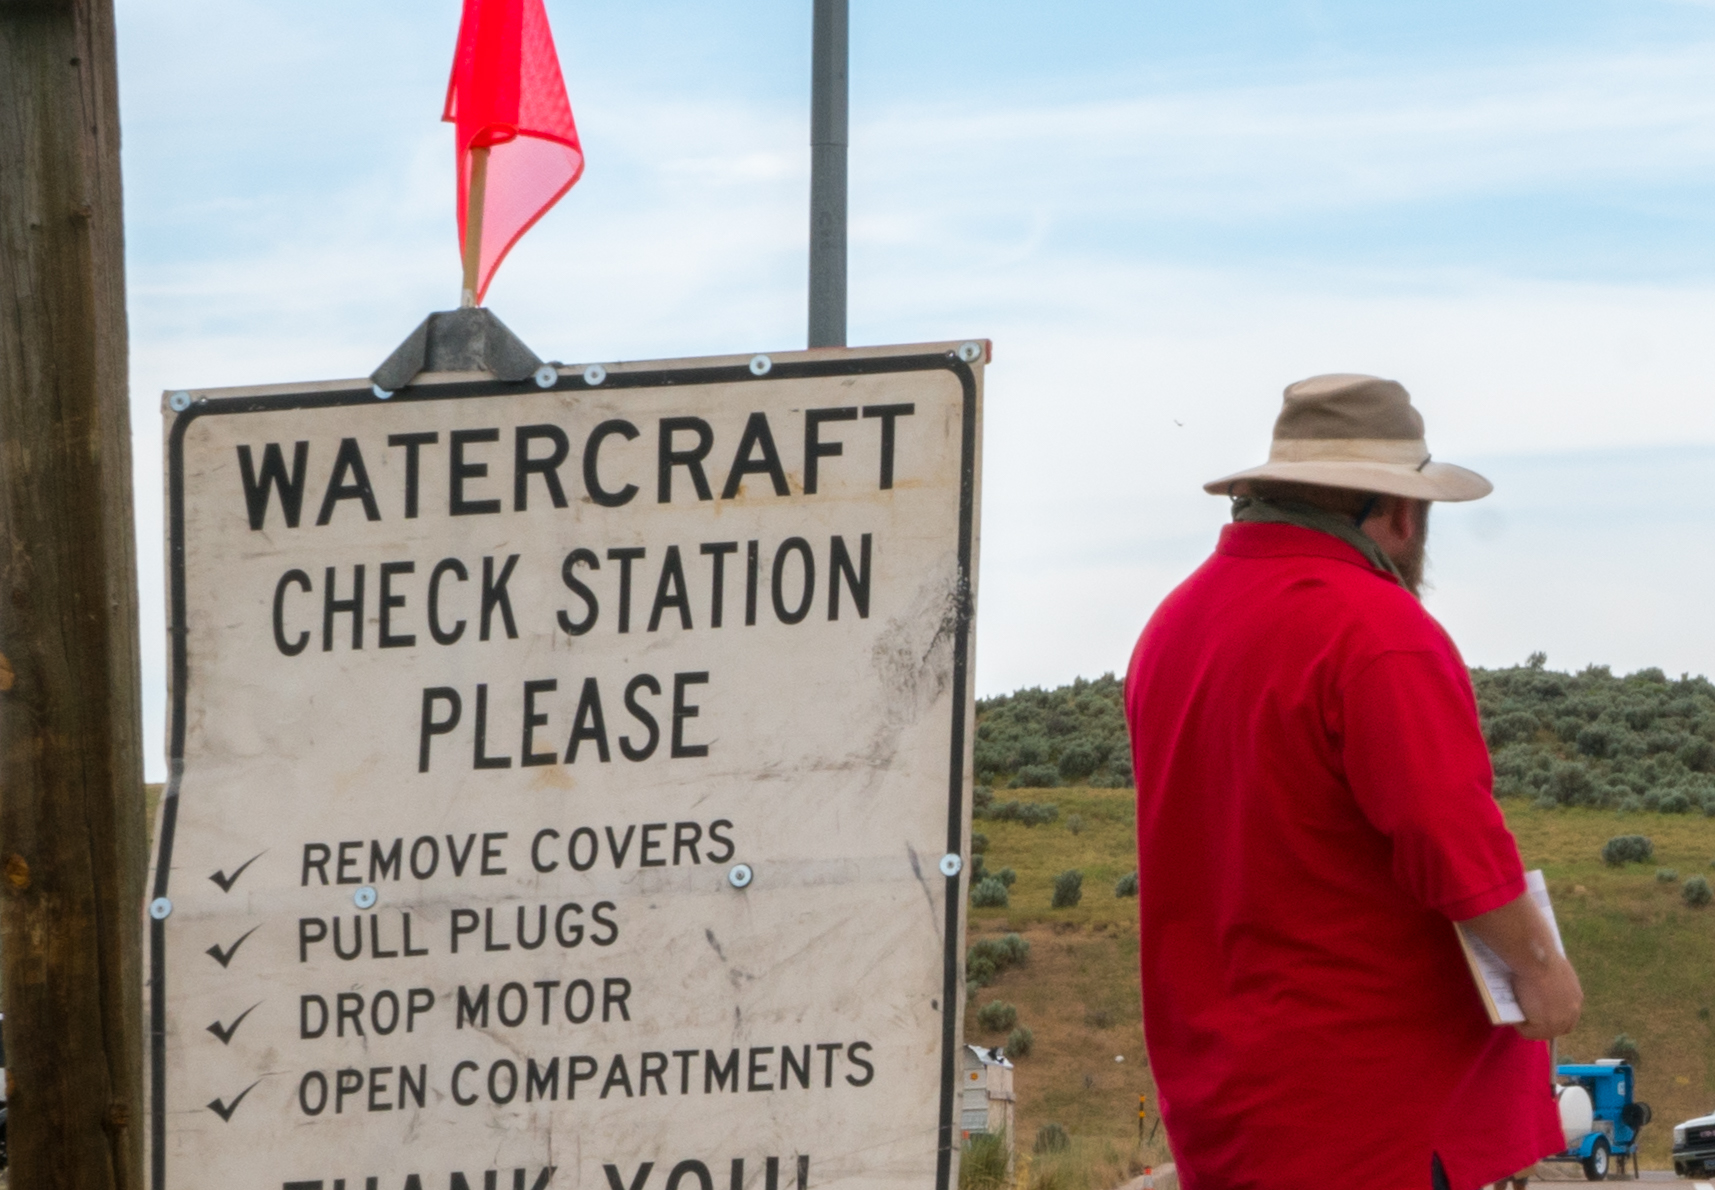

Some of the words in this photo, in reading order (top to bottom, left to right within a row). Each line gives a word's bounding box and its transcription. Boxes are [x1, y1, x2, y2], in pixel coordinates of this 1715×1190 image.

[236, 402, 916, 532] WATERCRAFT
[272, 553, 520, 657] CHECK
[556, 532, 873, 637] STATION
[418, 671, 710, 773] PLEASE
[300, 831, 509, 887] REMOVE
[530, 819, 737, 874] COVERS
[298, 912, 429, 963] PULL
[450, 901, 620, 955] PLUGS
[299, 987, 436, 1040] DROP
[456, 977, 632, 1031] MOTOR
[298, 1060, 427, 1116] OPEN
[451, 1041, 876, 1107] COMPARTMENTS
